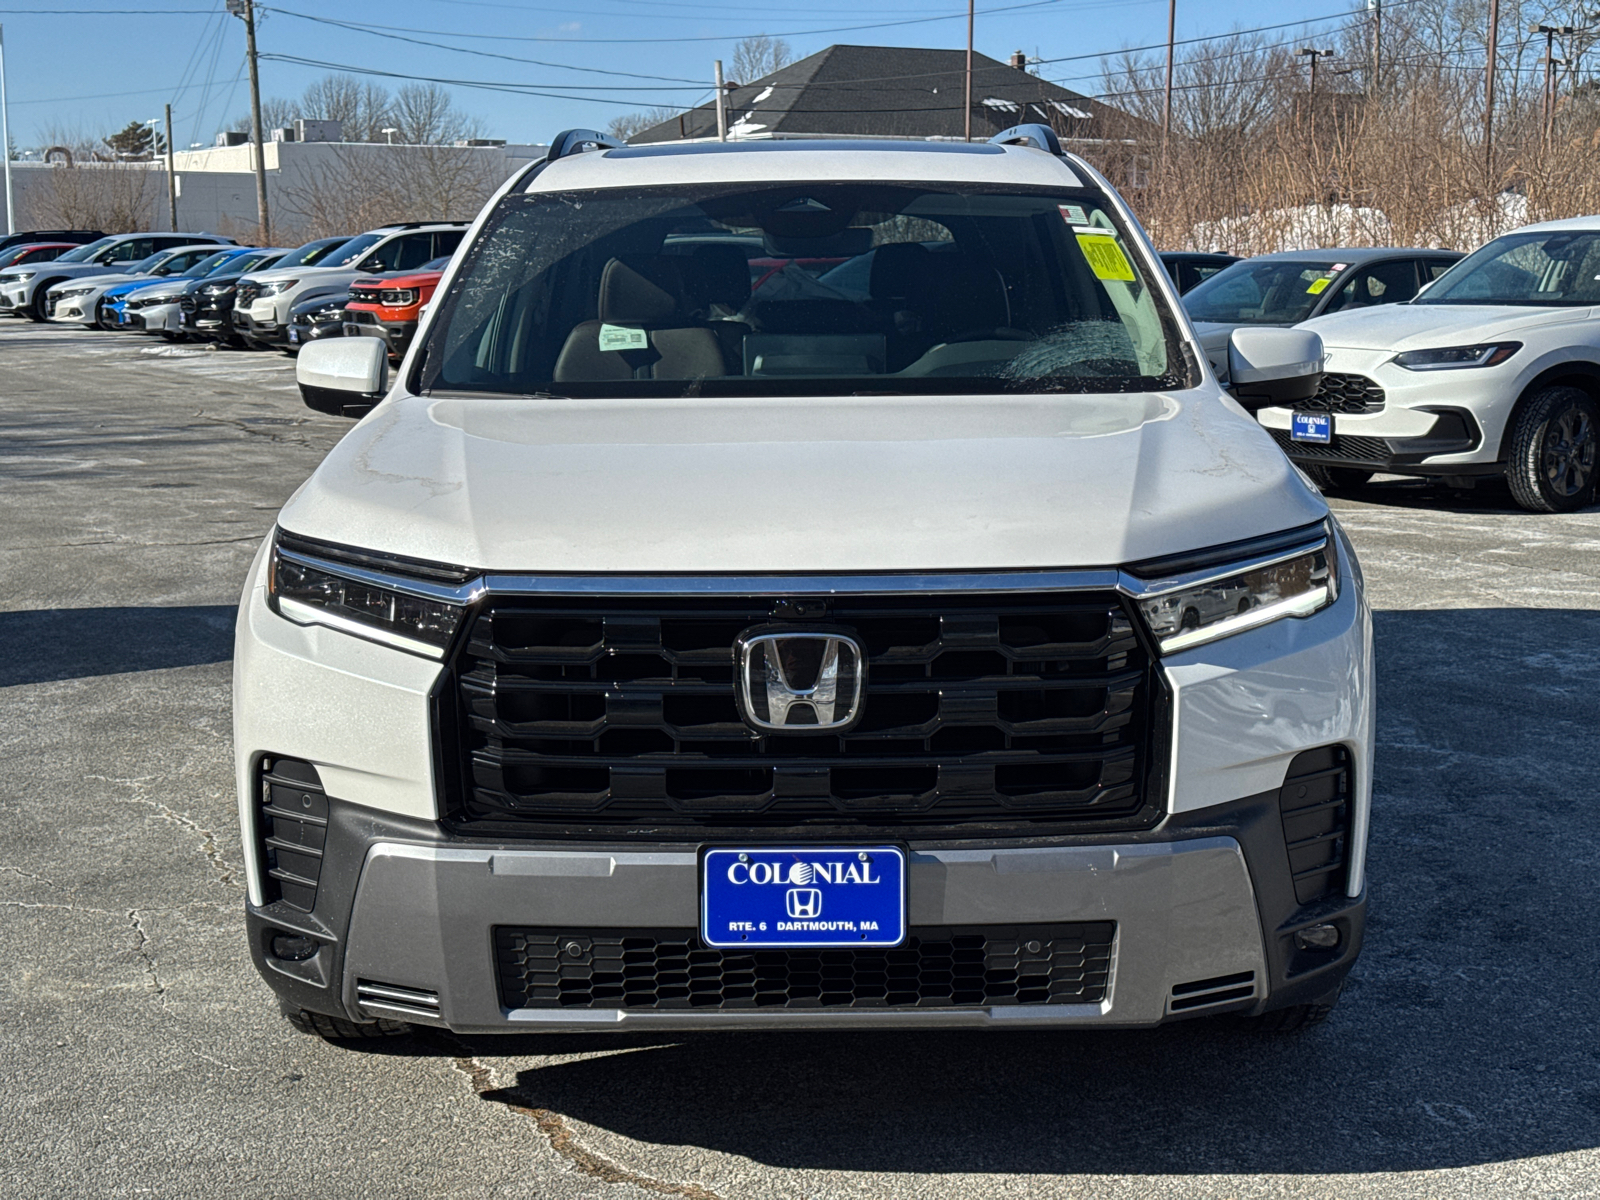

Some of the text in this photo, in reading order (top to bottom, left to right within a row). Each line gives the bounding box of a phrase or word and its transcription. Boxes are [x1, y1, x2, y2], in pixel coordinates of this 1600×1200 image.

[727, 861, 881, 885] COLONIAL
[728, 921, 879, 932] RTE. 6 DARTMOUTH, MA
